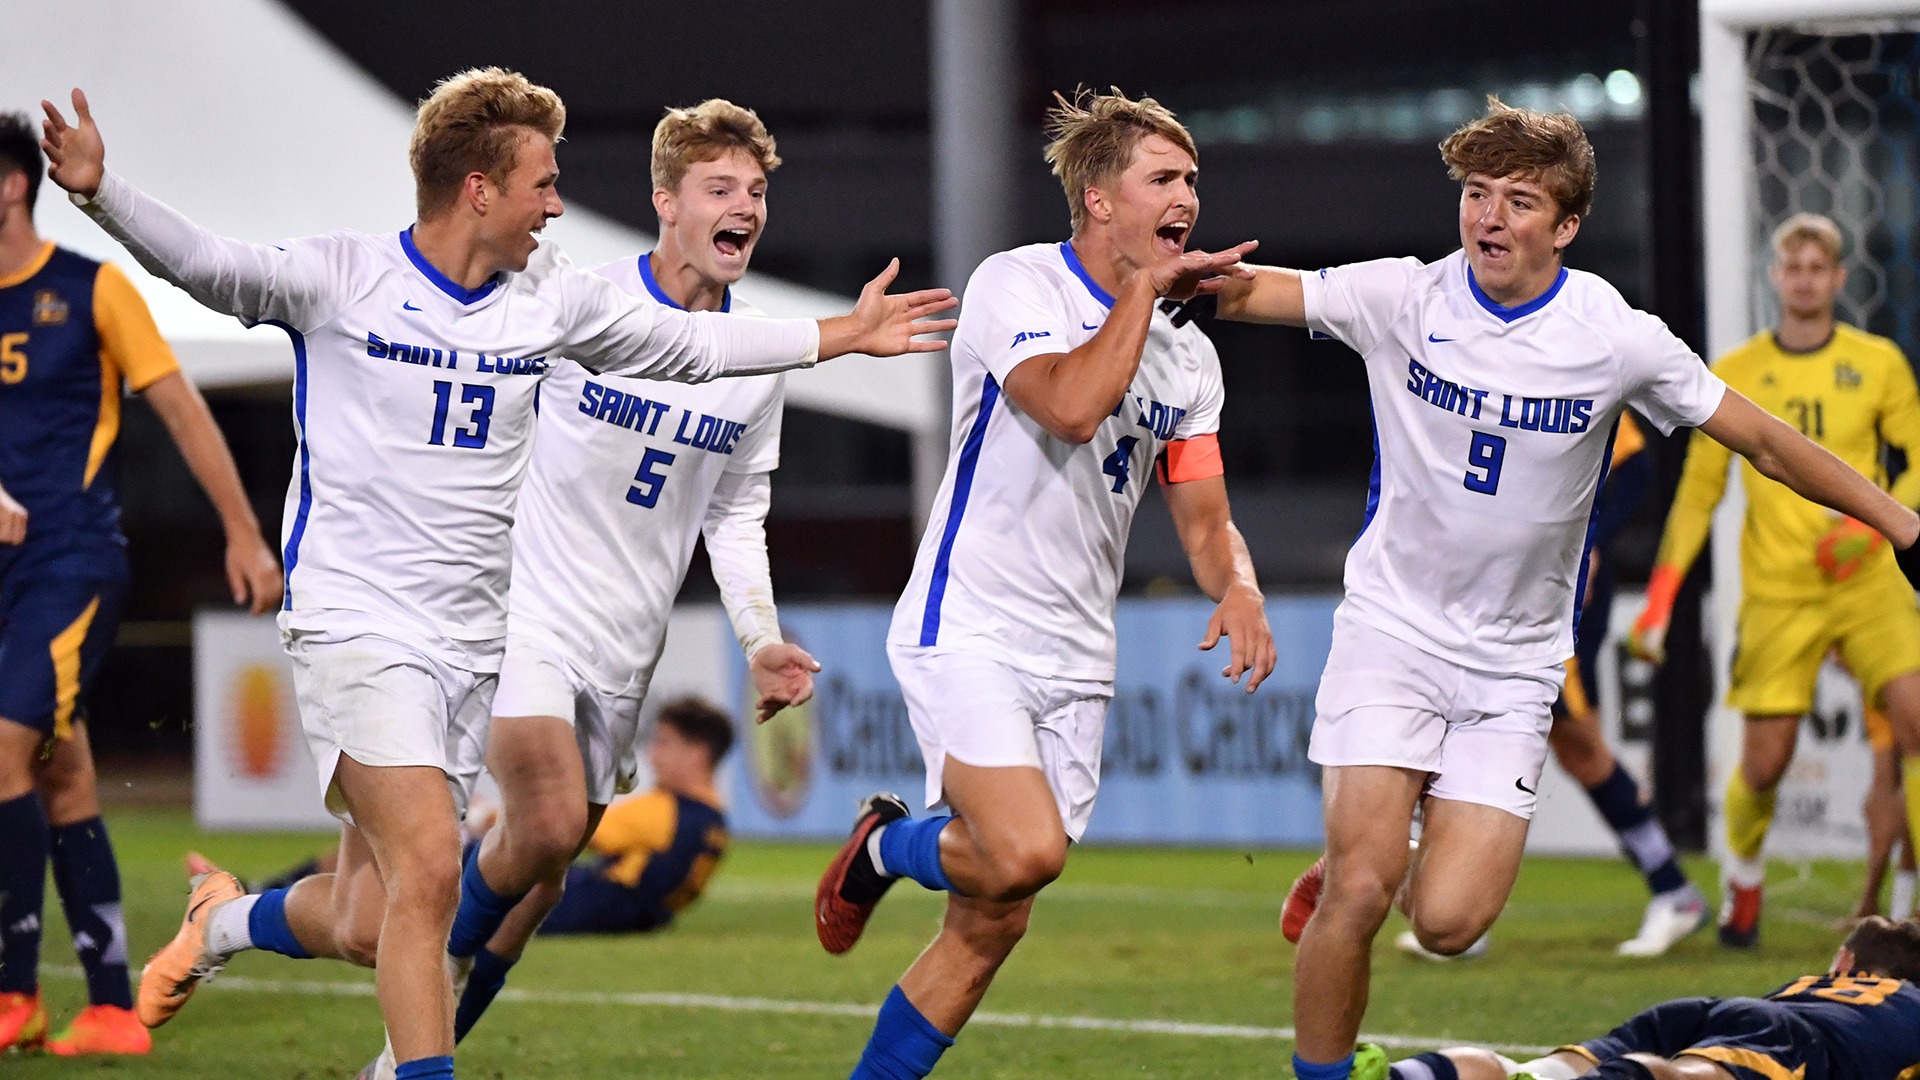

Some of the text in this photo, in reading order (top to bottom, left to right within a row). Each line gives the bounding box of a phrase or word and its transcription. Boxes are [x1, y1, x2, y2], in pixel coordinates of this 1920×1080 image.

[367, 331, 458, 369] SAINT
[428, 380, 496, 449] 13
[578, 380, 747, 455] SAINT LOUIS
[1407, 358, 1594, 434] SAINT LOUIS
[625, 446, 676, 509] 5
[1102, 434, 1140, 495] 4
[1463, 430, 1507, 496] 9
